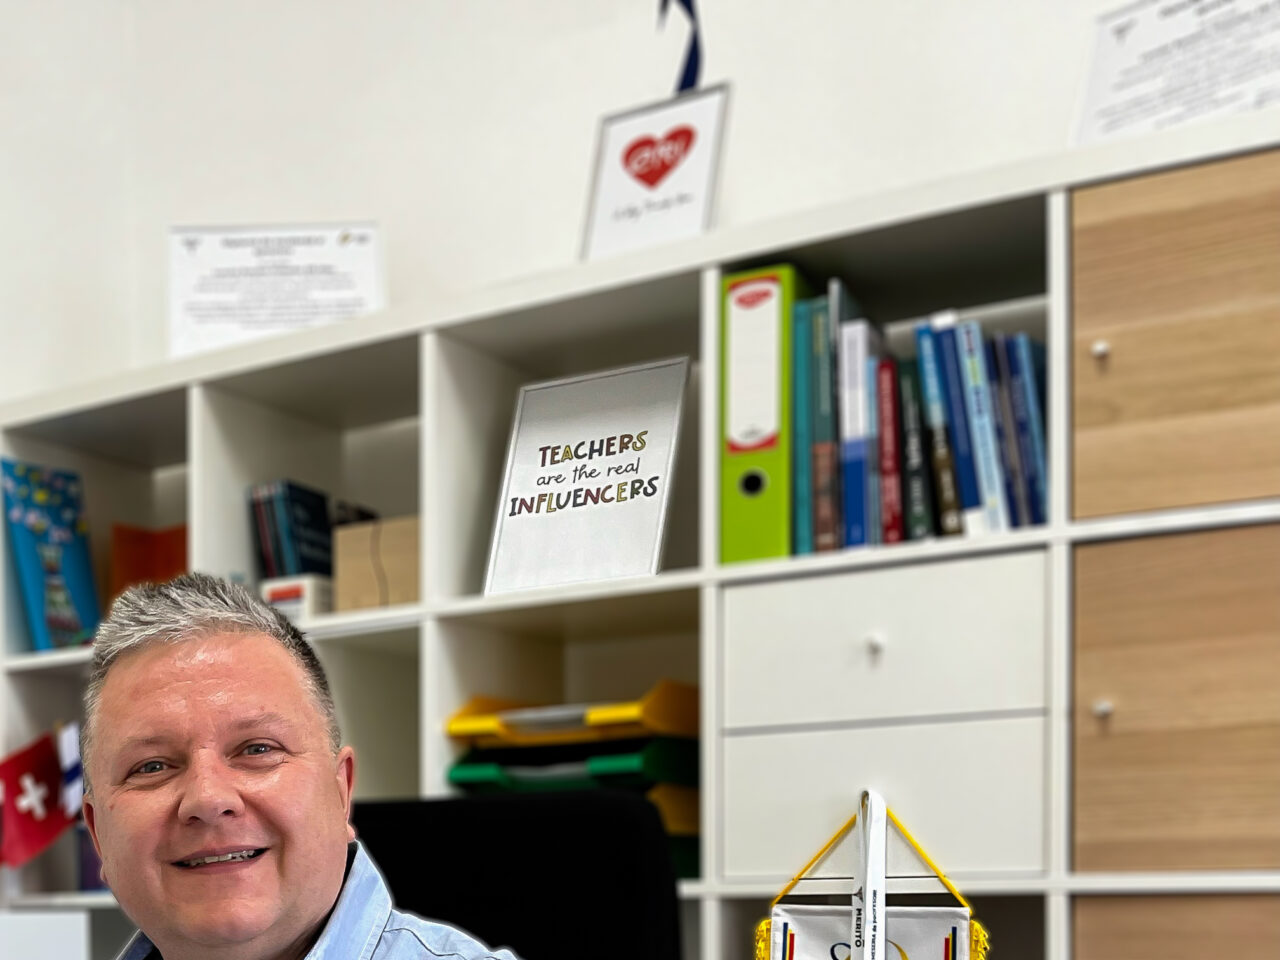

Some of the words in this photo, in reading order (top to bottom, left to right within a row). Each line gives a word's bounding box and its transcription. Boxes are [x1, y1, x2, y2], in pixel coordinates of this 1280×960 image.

[539, 430, 649, 468] TEACHERS
[536, 473, 567, 486] are
[572, 464, 602, 484] the
[606, 457, 641, 477] real
[508, 476, 660, 518] INFLUENCERS
